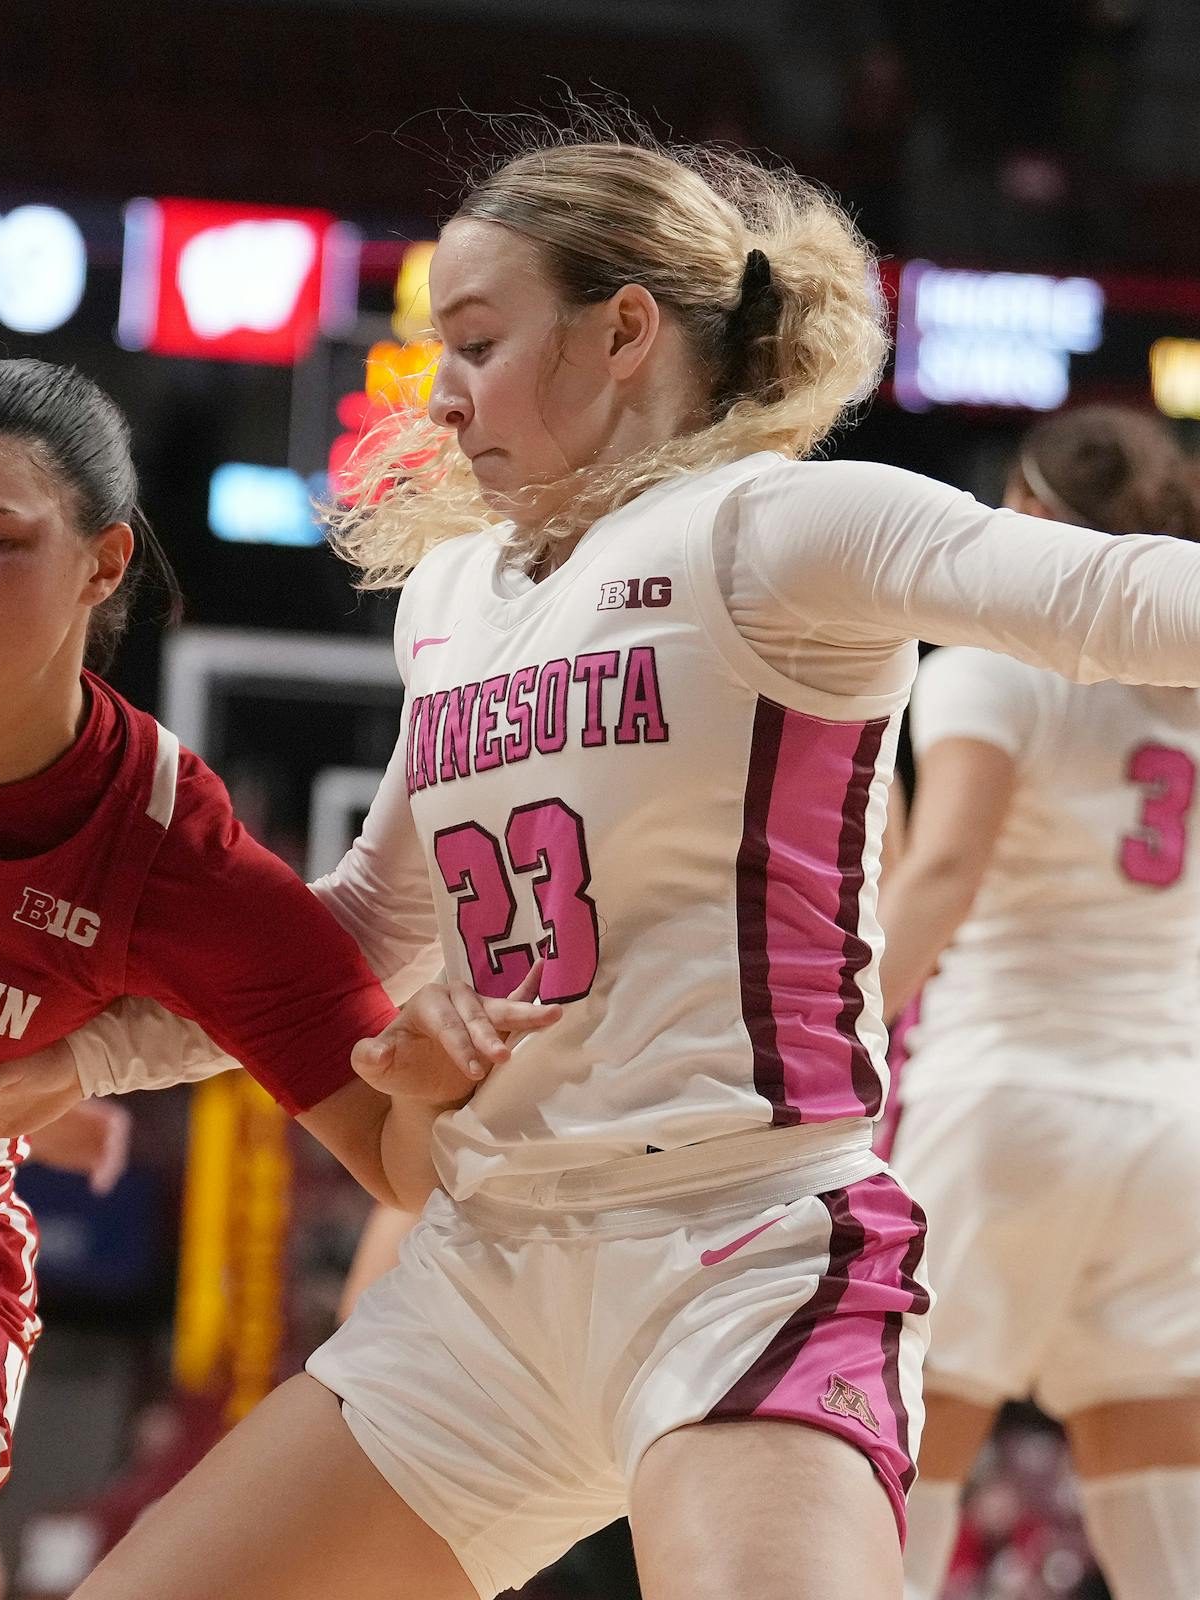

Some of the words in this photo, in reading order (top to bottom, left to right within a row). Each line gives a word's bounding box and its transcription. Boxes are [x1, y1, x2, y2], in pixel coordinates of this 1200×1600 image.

[406, 645, 670, 799] INNESOTA
[1117, 737, 1196, 889] 3
[433, 797, 600, 1005] 23
